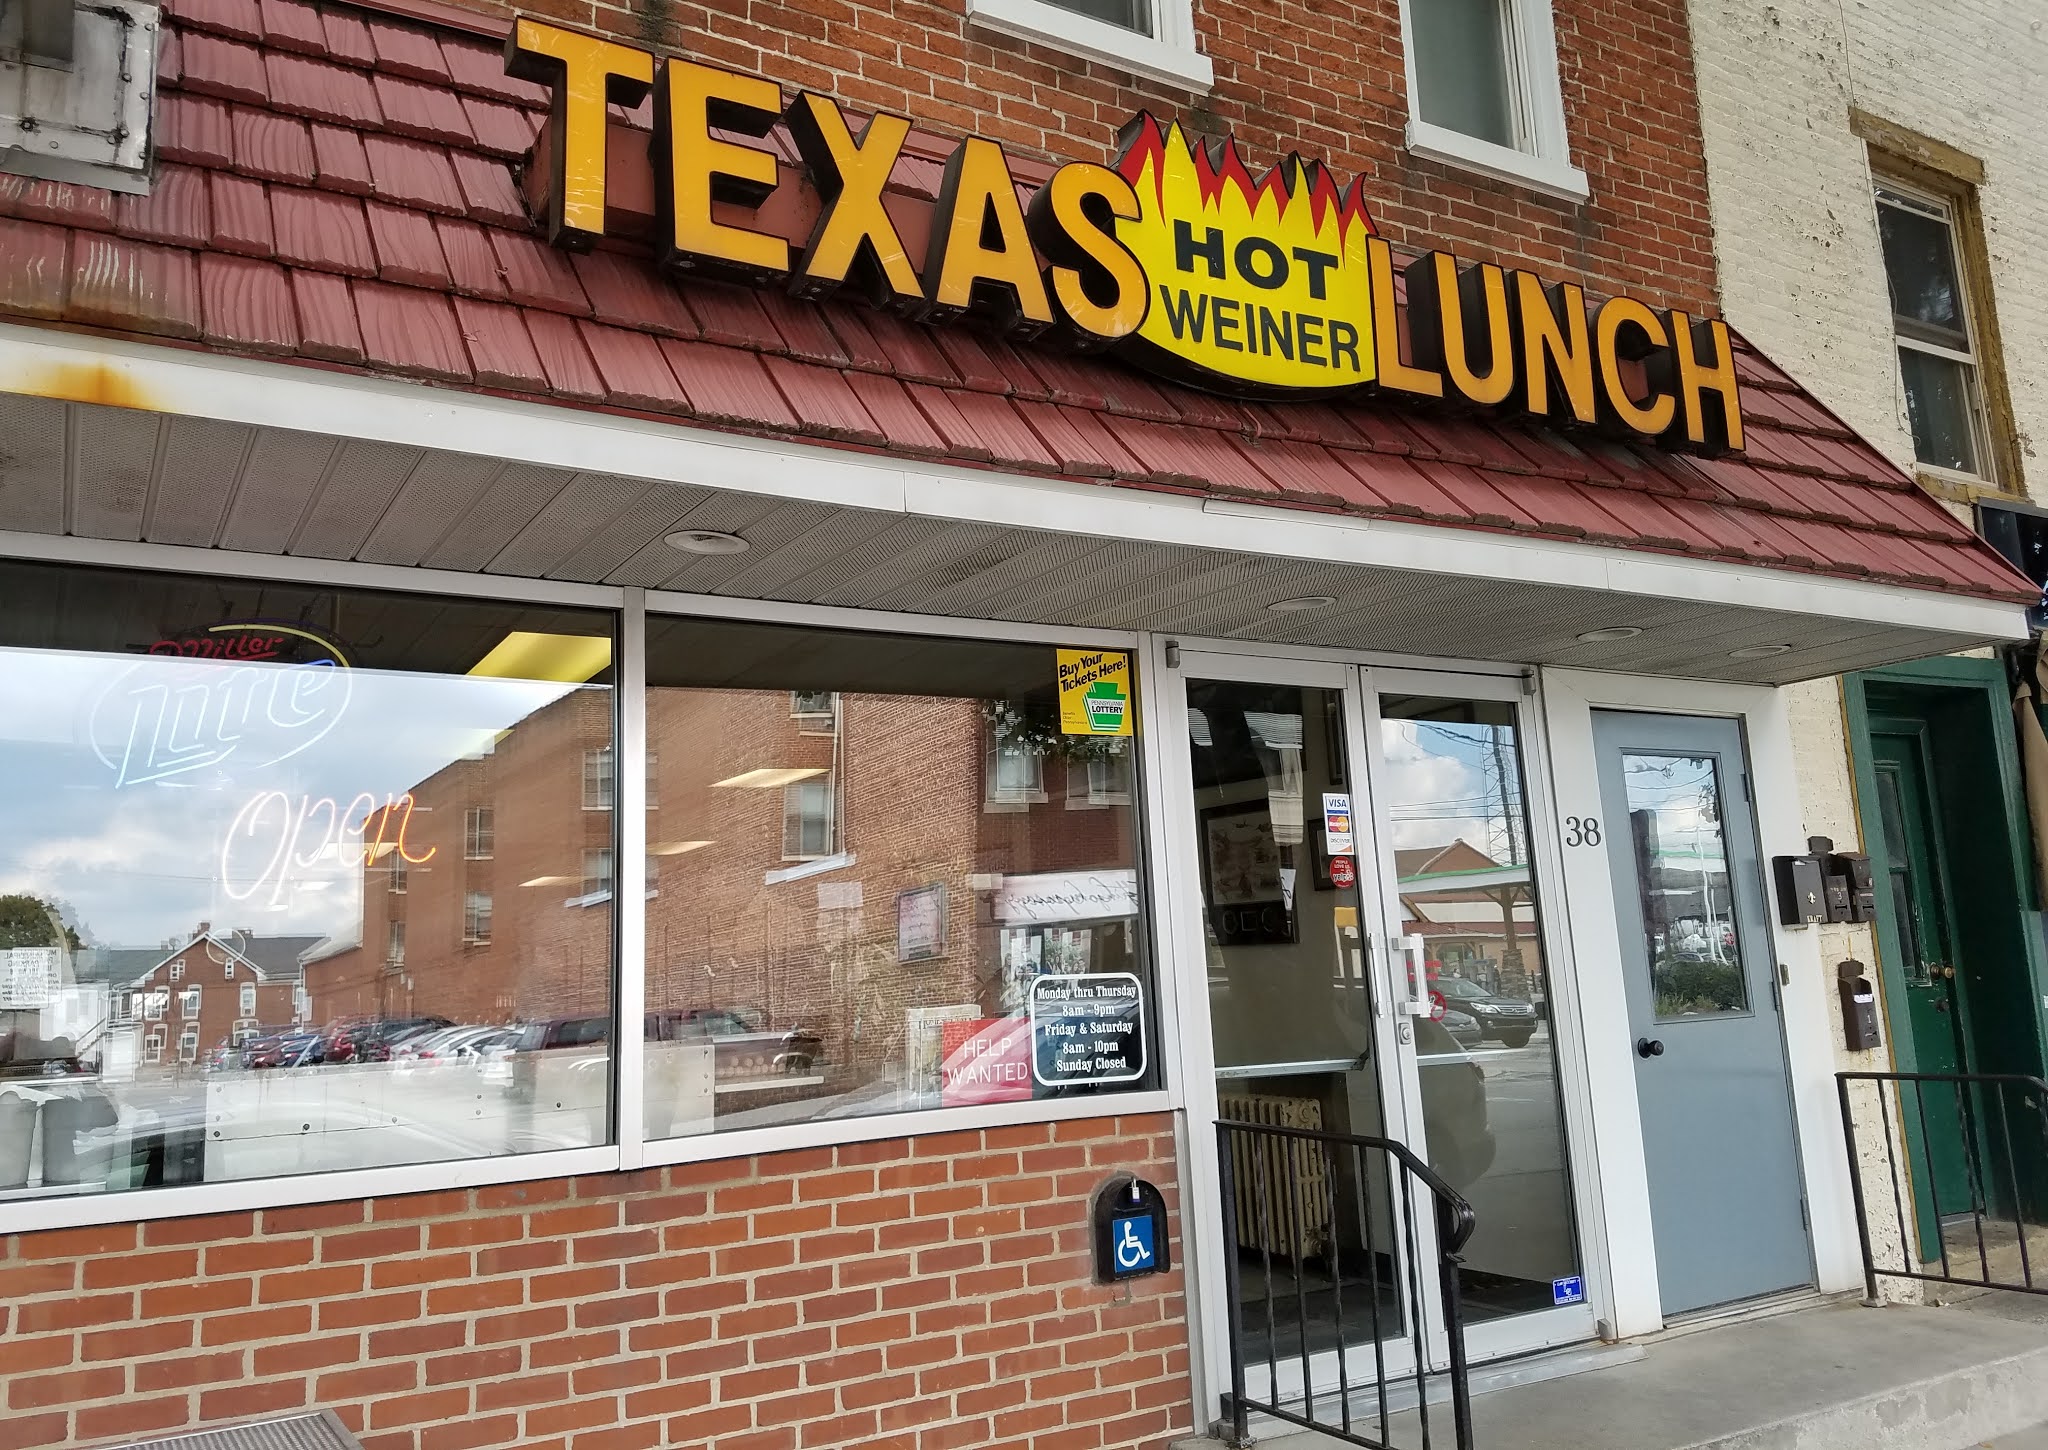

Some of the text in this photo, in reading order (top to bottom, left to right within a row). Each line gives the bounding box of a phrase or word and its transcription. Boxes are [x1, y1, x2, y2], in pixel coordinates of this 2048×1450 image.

[510, 15, 1151, 338] TEXAS
[1172, 219, 1340, 301] HOT
[1158, 283, 1361, 372] WEINER
[1366, 233, 1747, 453] LUNCH
[150, 636, 285, 661] Miller
[1059, 653, 1103, 679] Buy Your
[1061, 655, 1127, 692] Tickets Here!
[1091, 706, 1123, 714] LOTTERY
[115, 659, 337, 789] Lite
[1328, 799, 1347, 808] VISA
[1565, 815, 1602, 848] 38
[221, 791, 437, 906] Open
[1837, 891, 1843, 900] 3
[1036, 985, 1136, 1001] Monday thru Thursday
[1062, 1005, 1084, 1017] 8am
[1094, 1004, 1115, 1017] 9pm
[1045, 1021, 1133, 1037] Friday & Saturday
[963, 1037, 1012, 1058] HELP
[1062, 1042, 1085, 1054] 8am
[1094, 1040, 1119, 1054] 10pm
[946, 1062, 1028, 1086] WANTED
[1056, 1056, 1127, 1072] Sunday Closed
